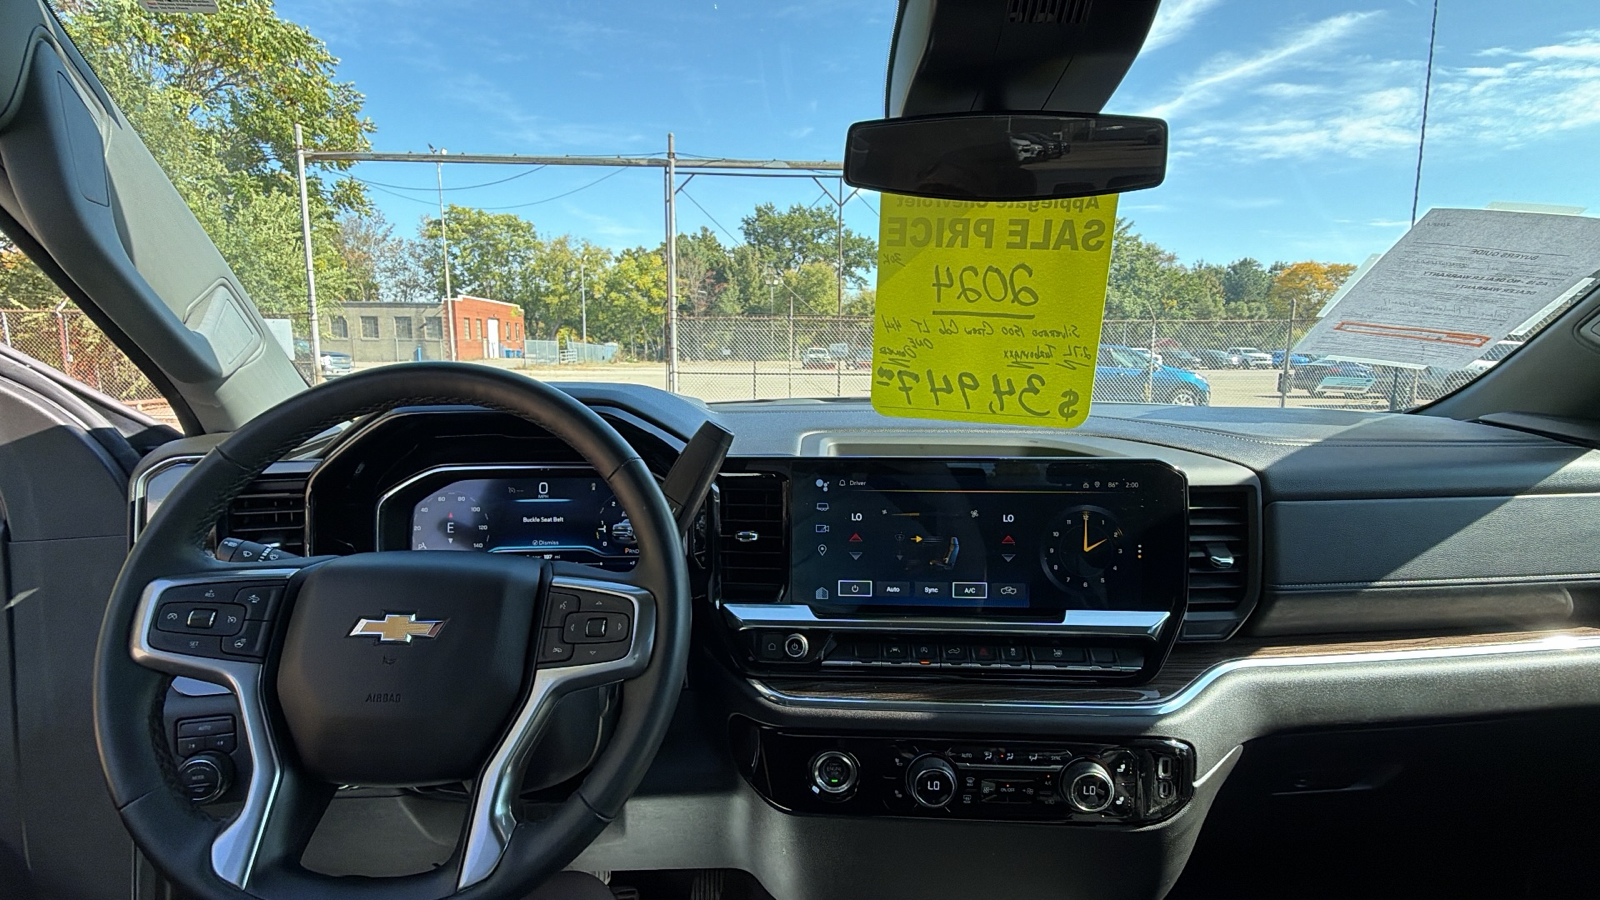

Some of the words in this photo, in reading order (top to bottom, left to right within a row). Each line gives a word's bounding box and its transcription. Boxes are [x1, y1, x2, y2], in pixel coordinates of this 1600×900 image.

[539, 482, 548, 494] 0
[851, 513, 862, 521] LO
[1003, 514, 1014, 522] LO
[447, 522, 454, 533] E
[365, 693, 401, 703] AIRBAG
[927, 780, 940, 790] LO
[1083, 785, 1096, 796] LO
